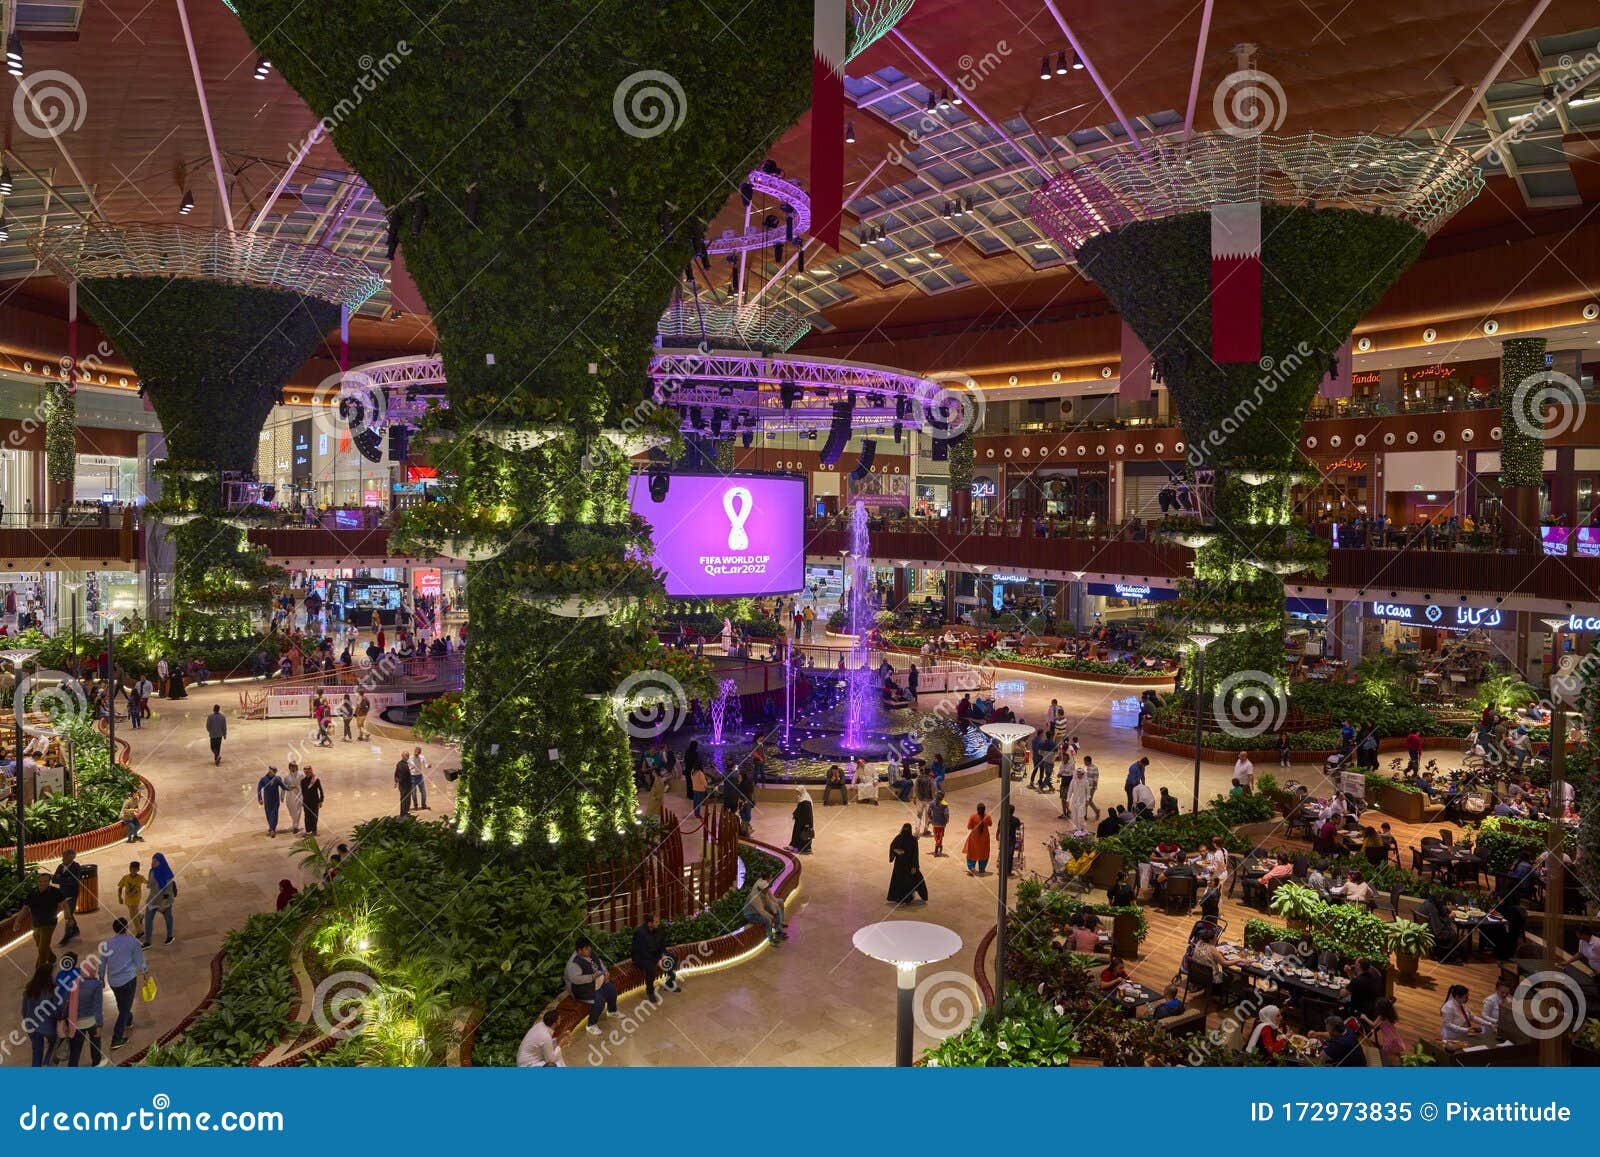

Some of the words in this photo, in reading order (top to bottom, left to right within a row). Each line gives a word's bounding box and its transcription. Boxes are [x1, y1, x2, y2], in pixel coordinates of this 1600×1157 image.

[700, 556, 722, 565] FIFA
[722, 556, 754, 565] WORLD
[755, 555, 770, 564] CUP
